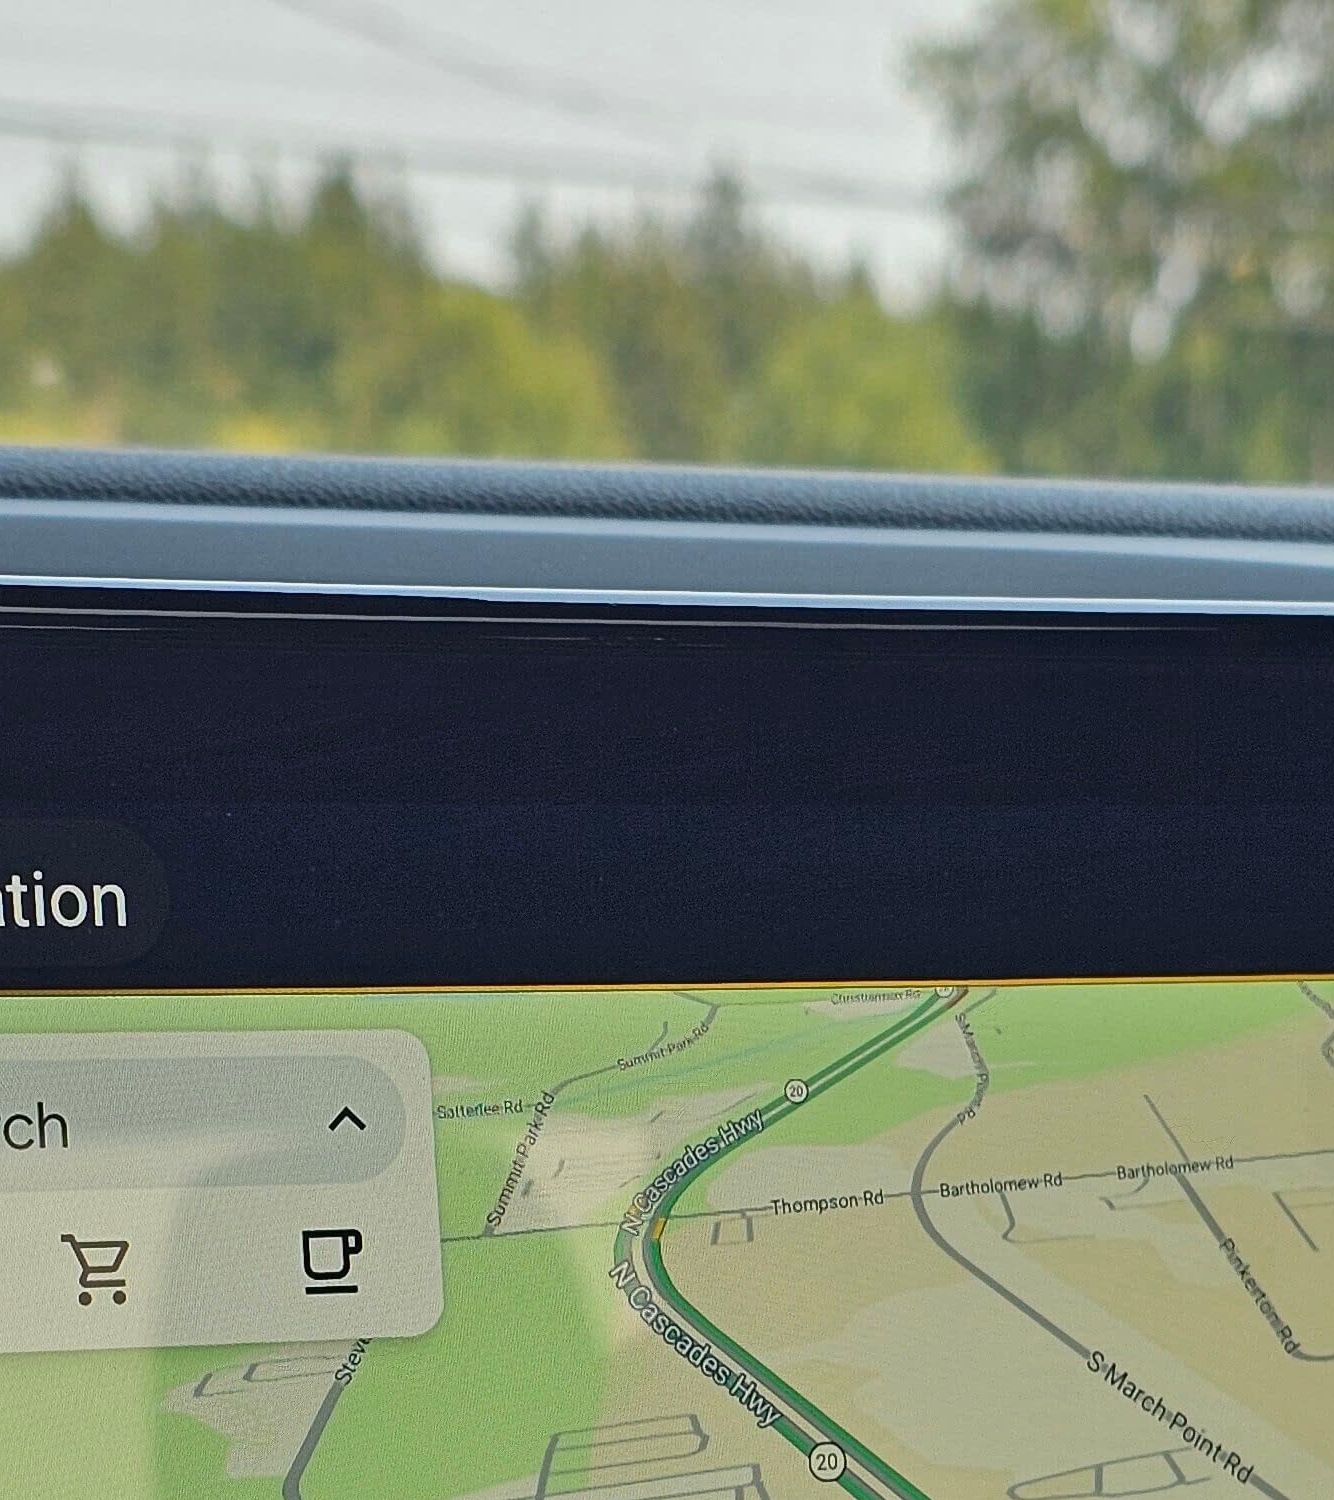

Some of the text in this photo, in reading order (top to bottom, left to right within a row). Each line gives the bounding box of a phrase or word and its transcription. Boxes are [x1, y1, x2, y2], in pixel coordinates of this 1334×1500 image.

[789, 1084, 804, 1098] 20
[504, 1099, 524, 1115] Rd
[486, 1090, 556, 1227] Summit Park Rd
[1116, 1155, 1234, 1181] Bartholomew Rd
[620, 1109, 765, 1236] N Cascades Hwy
[939, 1171, 1063, 1198] Bartholomew Rd
[770, 1189, 885, 1216] Thompson Rd
[1219, 1238, 1301, 1354] Pinkerton Rd
[609, 1260, 783, 1428] N Cascades Hwy
[1086, 1350, 1255, 1484] S March Point Rd
[815, 1451, 839, 1472] 20
